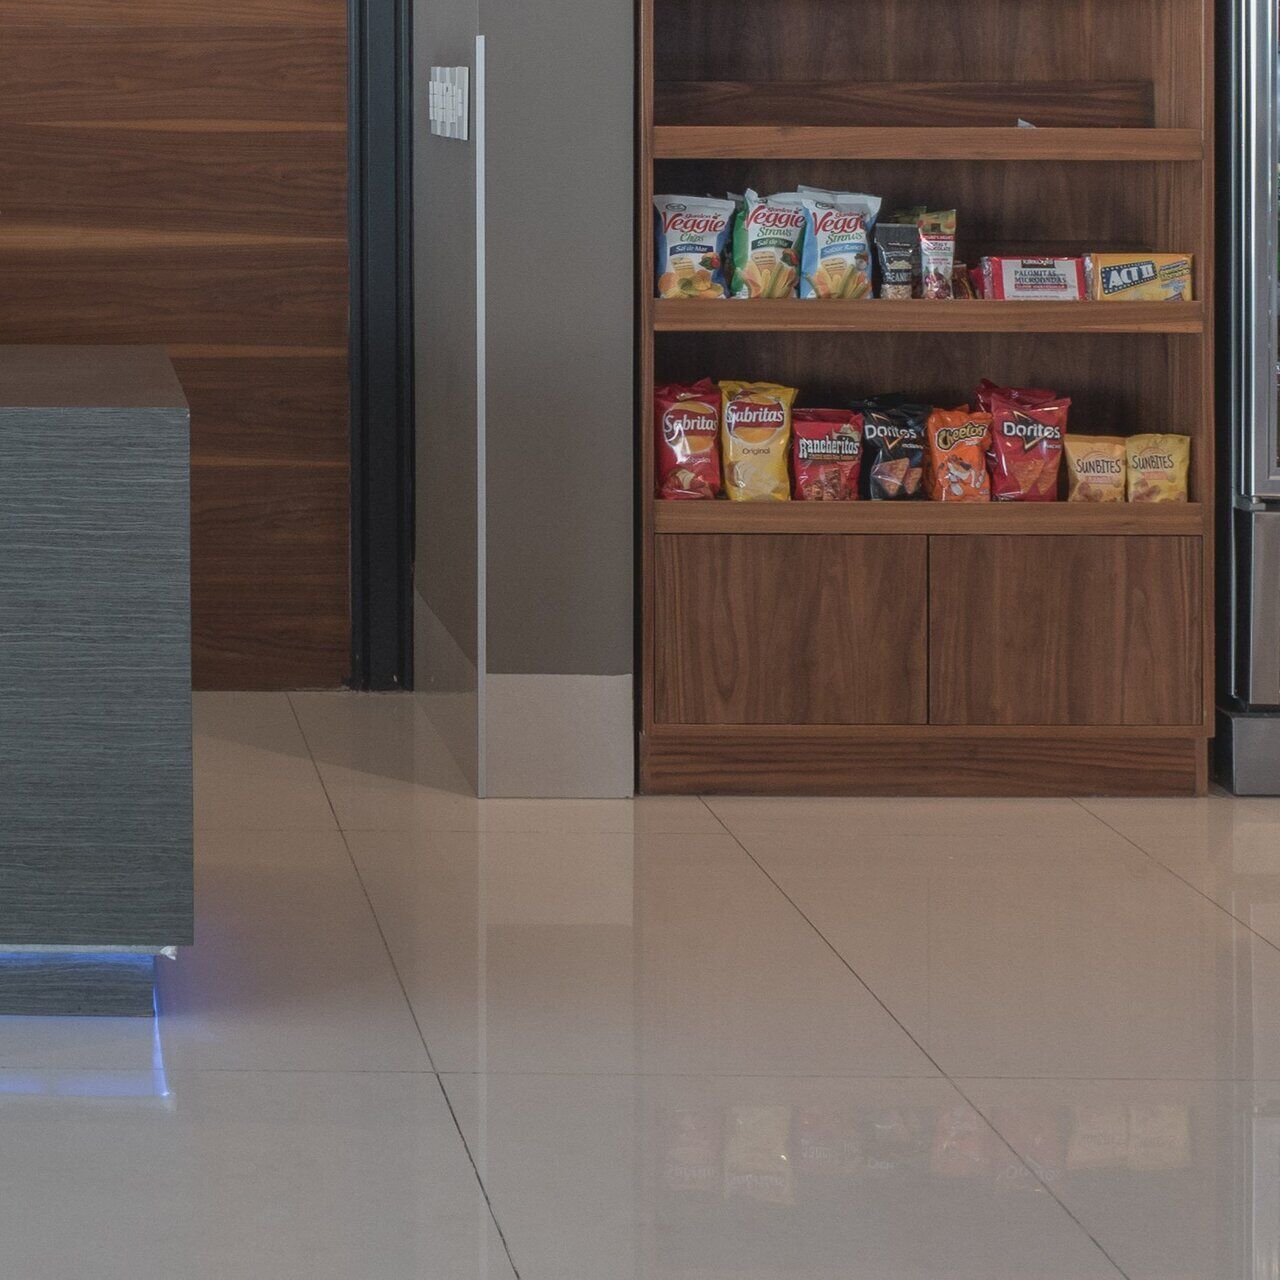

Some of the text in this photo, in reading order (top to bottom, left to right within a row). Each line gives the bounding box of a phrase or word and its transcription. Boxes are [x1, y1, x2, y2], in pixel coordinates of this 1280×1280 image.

[661, 211, 726, 234] Veggie
[744, 204, 806, 228] Veggie
[1108, 266, 1139, 289] ACT
[1140, 263, 1154, 279] II
[664, 413, 719, 433] Sabritas
[726, 405, 785, 423] Sabritas
[865, 424, 917, 440] Doritos
[936, 421, 988, 451] Cheetos
[1003, 421, 1061, 439] Doritos
[741, 448, 771, 457] Original
[798, 434, 860, 459] Rancheritos
[1075, 458, 1121, 475] SUNBITES
[1131, 454, 1175, 471] SUNBITES
